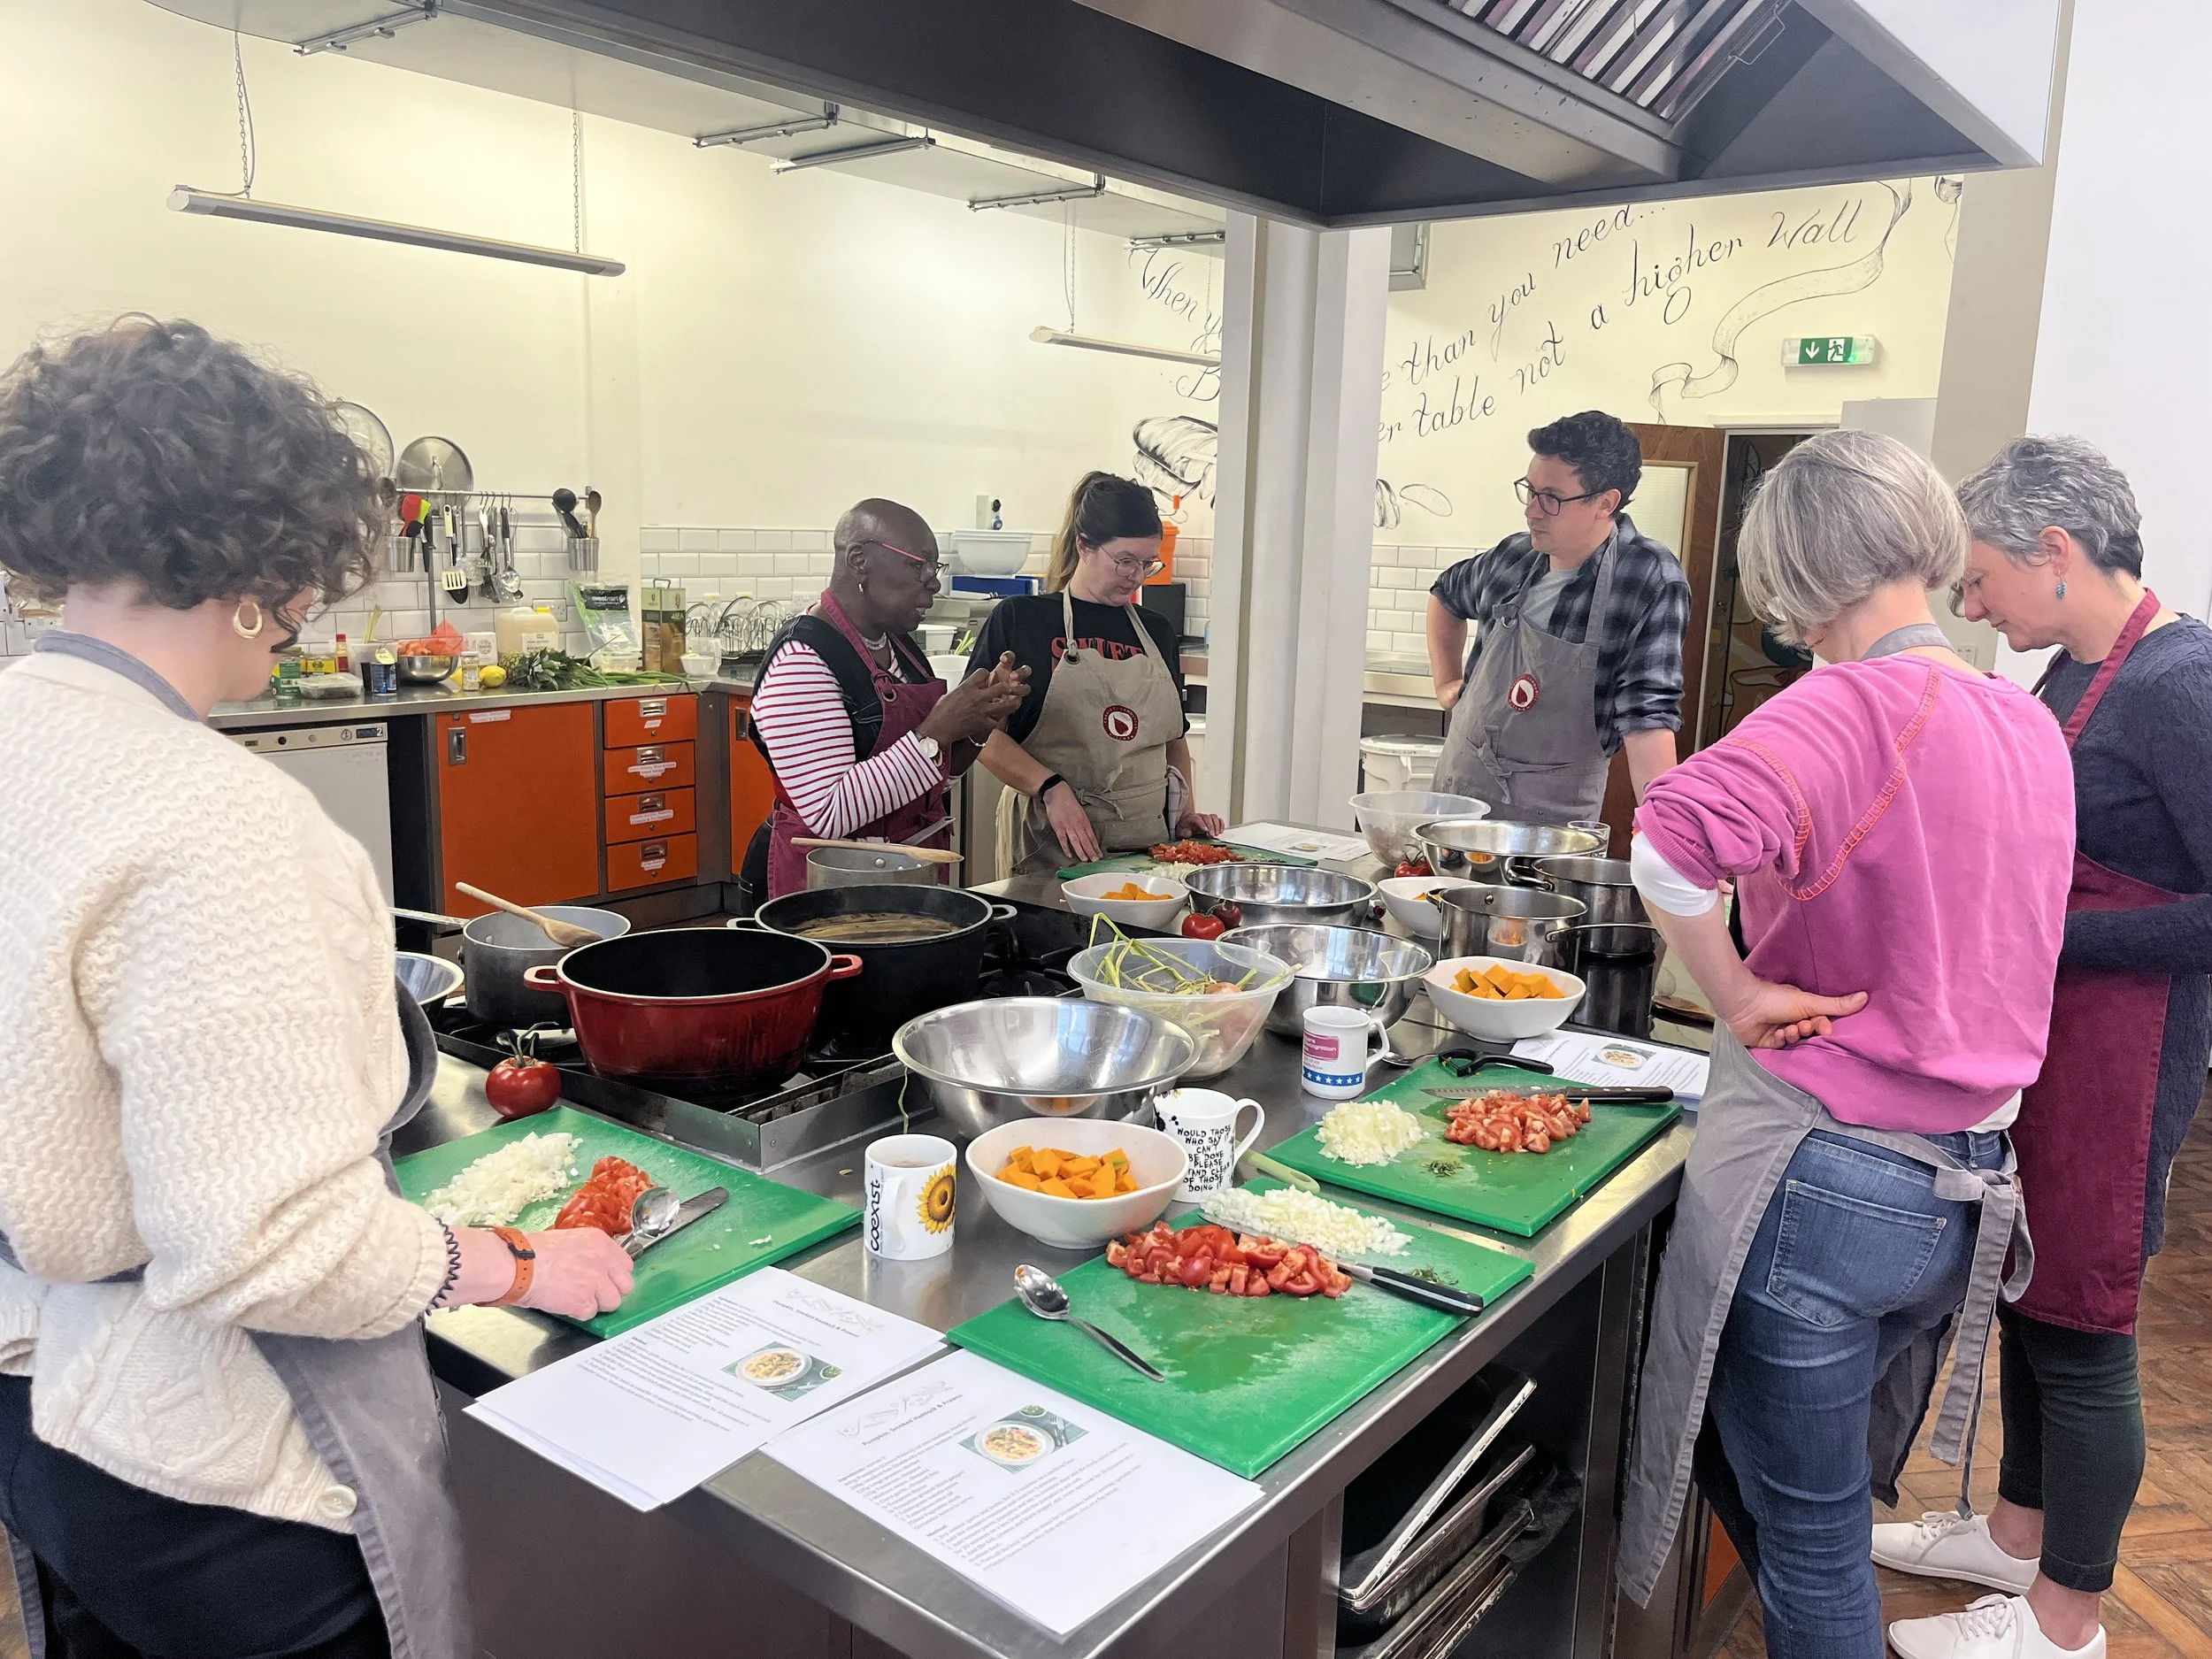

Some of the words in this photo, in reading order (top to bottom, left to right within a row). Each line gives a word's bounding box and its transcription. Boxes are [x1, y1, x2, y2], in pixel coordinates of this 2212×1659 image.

[1128, 247, 1198, 322] When
[1397, 329, 1476, 386] than
[1487, 273, 1536, 362] you
[1412, 373, 1496, 437] table
[1509, 321, 1566, 396] not
[1589, 304, 1609, 330] a
[1622, 223, 1744, 325] higher
[1767, 198, 1863, 250] Wall
[1178, 1128, 1206, 1137] WOULD
[1210, 1125, 1231, 1135] THOSE
[1186, 1136, 1203, 1145] WHO
[1204, 1150, 1224, 1160] DONE
[1194, 1158, 1223, 1169] PLEASE
[1188, 1169, 1207, 1178] TAND
[1199, 1173, 1224, 1183] THOSE
[861, 1430, 891, 1446] Pumpkin,
[888, 1418, 915, 1432] Smoked
[910, 1406, 938, 1420] Haddock
[941, 1393, 964, 1405] Prawns
